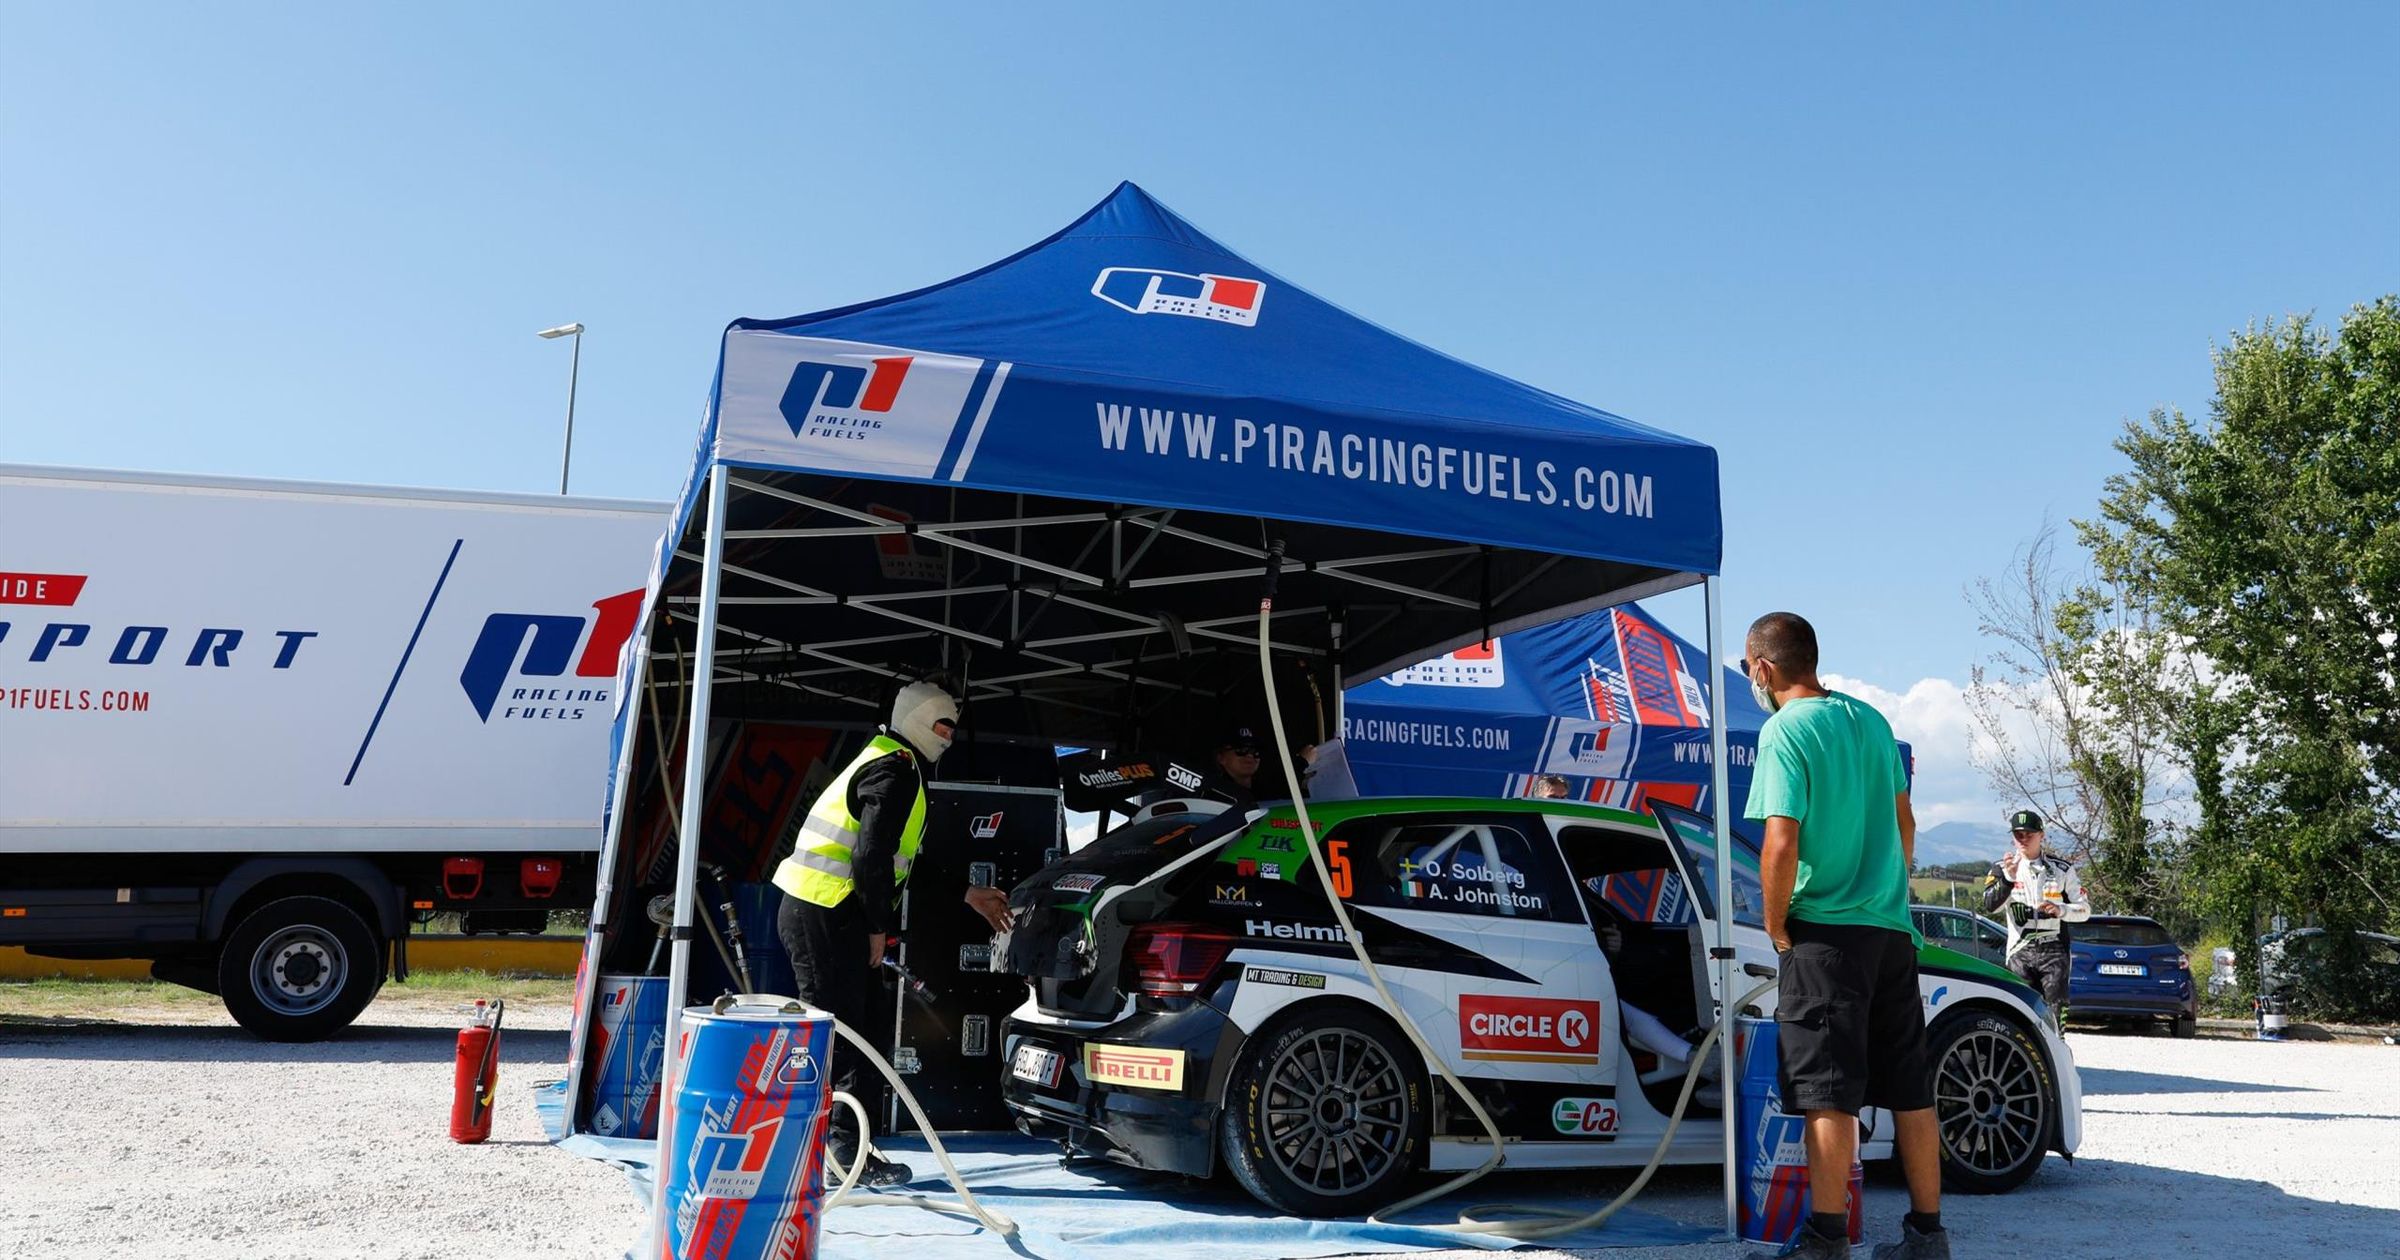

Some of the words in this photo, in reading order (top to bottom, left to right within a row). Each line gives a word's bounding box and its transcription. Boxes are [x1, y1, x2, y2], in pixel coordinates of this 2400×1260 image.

[815, 414, 883, 429] RACING
[809, 427, 867, 440] FUELS
[1096, 402, 1653, 519] WWW.P1RACINGFUELS.COM
[512, 688, 608, 702] RACING
[504, 706, 585, 719] FUELS
[1168, 767, 1202, 788] OMP
[1328, 840, 1353, 898] 5
[1426, 860, 1447, 878] O.
[1452, 863, 1525, 889] Solberg
[1429, 883, 1449, 900] A.
[1454, 886, 1542, 909] Johnston
[1248, 969, 1259, 981] MT
[1260, 970, 1291, 985] TRADING
[1291, 976, 1298, 985] &
[1298, 975, 1324, 988] DESIGN
[1469, 1012, 1552, 1039] CIRCLE
[1565, 1018, 1587, 1044] K
[1089, 1050, 1174, 1082] PIRELLI
[712, 1176, 756, 1186] RACING
[708, 1187, 744, 1196] FUELS
